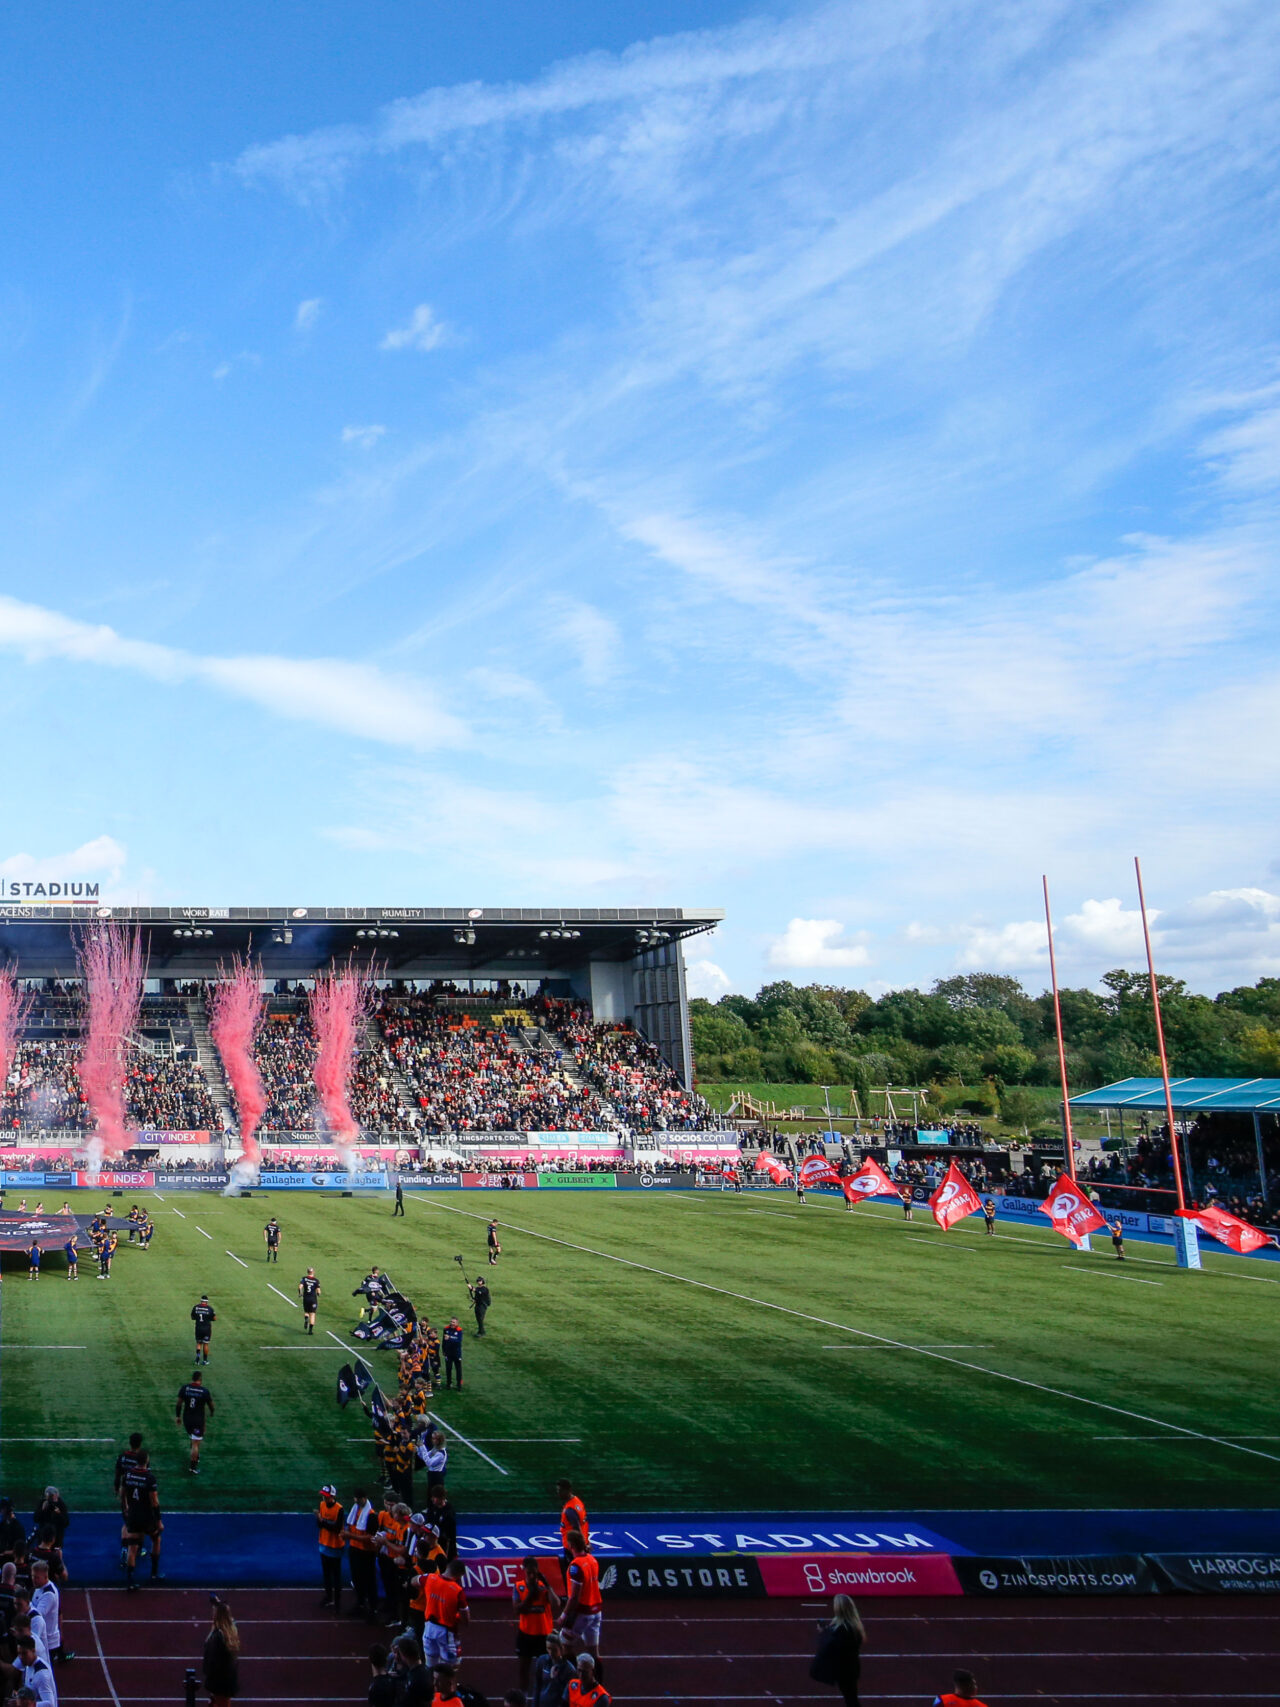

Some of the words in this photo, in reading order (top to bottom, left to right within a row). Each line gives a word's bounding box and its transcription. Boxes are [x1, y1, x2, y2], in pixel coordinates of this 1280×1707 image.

[10, 883, 99, 896] STADIUM
[183, 909, 208, 917] WORK
[210, 909, 228, 917] RATE
[382, 909, 421, 917] HUMILITY
[144, 1133, 166, 1141] CITY
[168, 1133, 196, 1141] INDEX
[113, 1174, 146, 1183] INDEX
[158, 1175, 227, 1183] DEFENDER
[261, 1175, 306, 1185] Gallagher
[398, 1175, 431, 1185] Funding
[433, 1175, 458, 1183] Circle
[657, 1532, 933, 1548] STADIUM
[1188, 1558, 1280, 1575] HARROGA
[628, 1568, 748, 1588] CASTORE
[828, 1567, 917, 1585] shawbrook
[1000, 1573, 1137, 1587] ZINCSPORTS.COM
